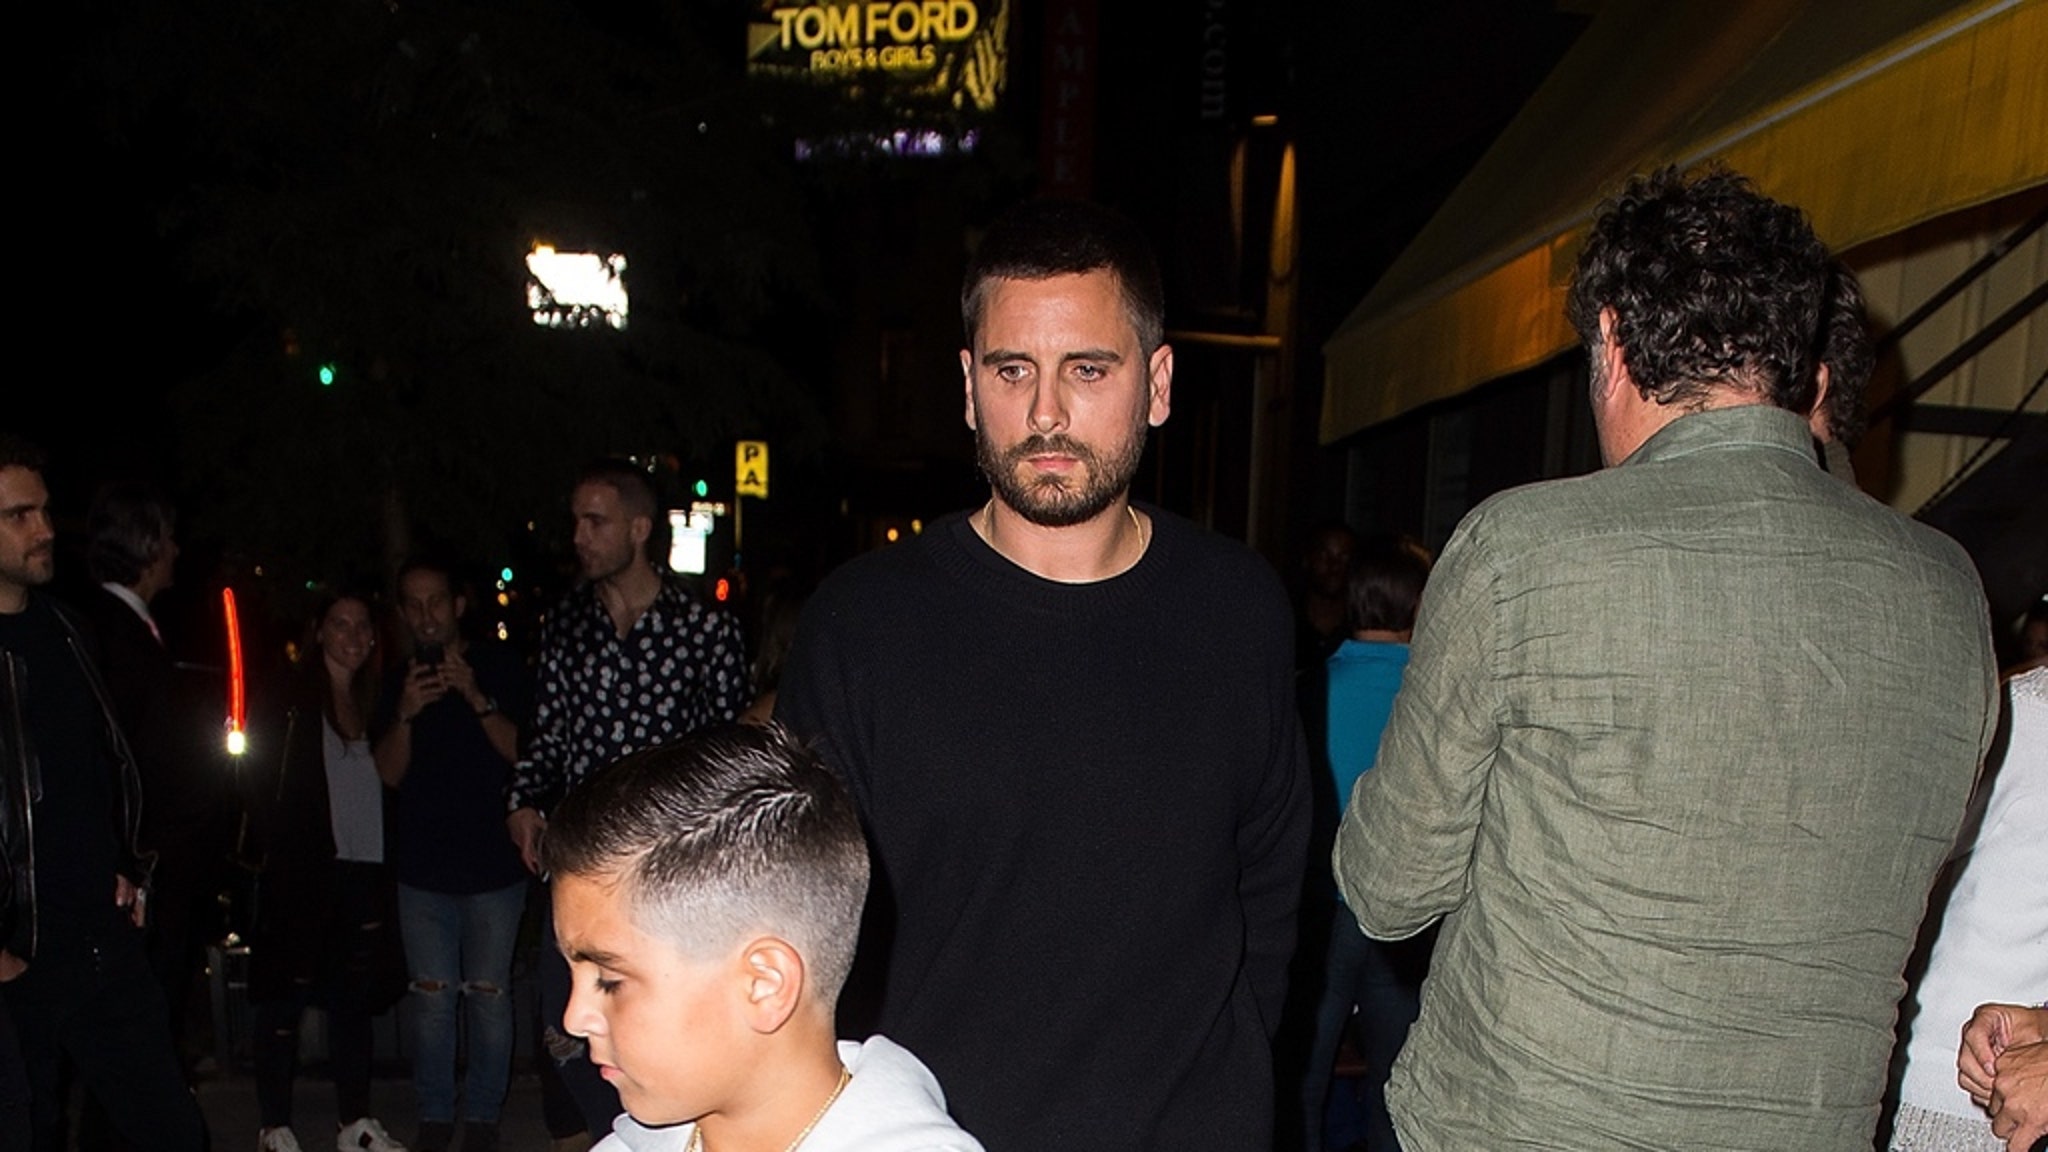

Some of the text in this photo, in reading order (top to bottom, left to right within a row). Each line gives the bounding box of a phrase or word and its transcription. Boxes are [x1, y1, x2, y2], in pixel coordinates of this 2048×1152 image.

[772, 0, 978, 50] TOM FORD
[811, 47, 862, 72] BOYS
[880, 44, 937, 70] GIRLS
